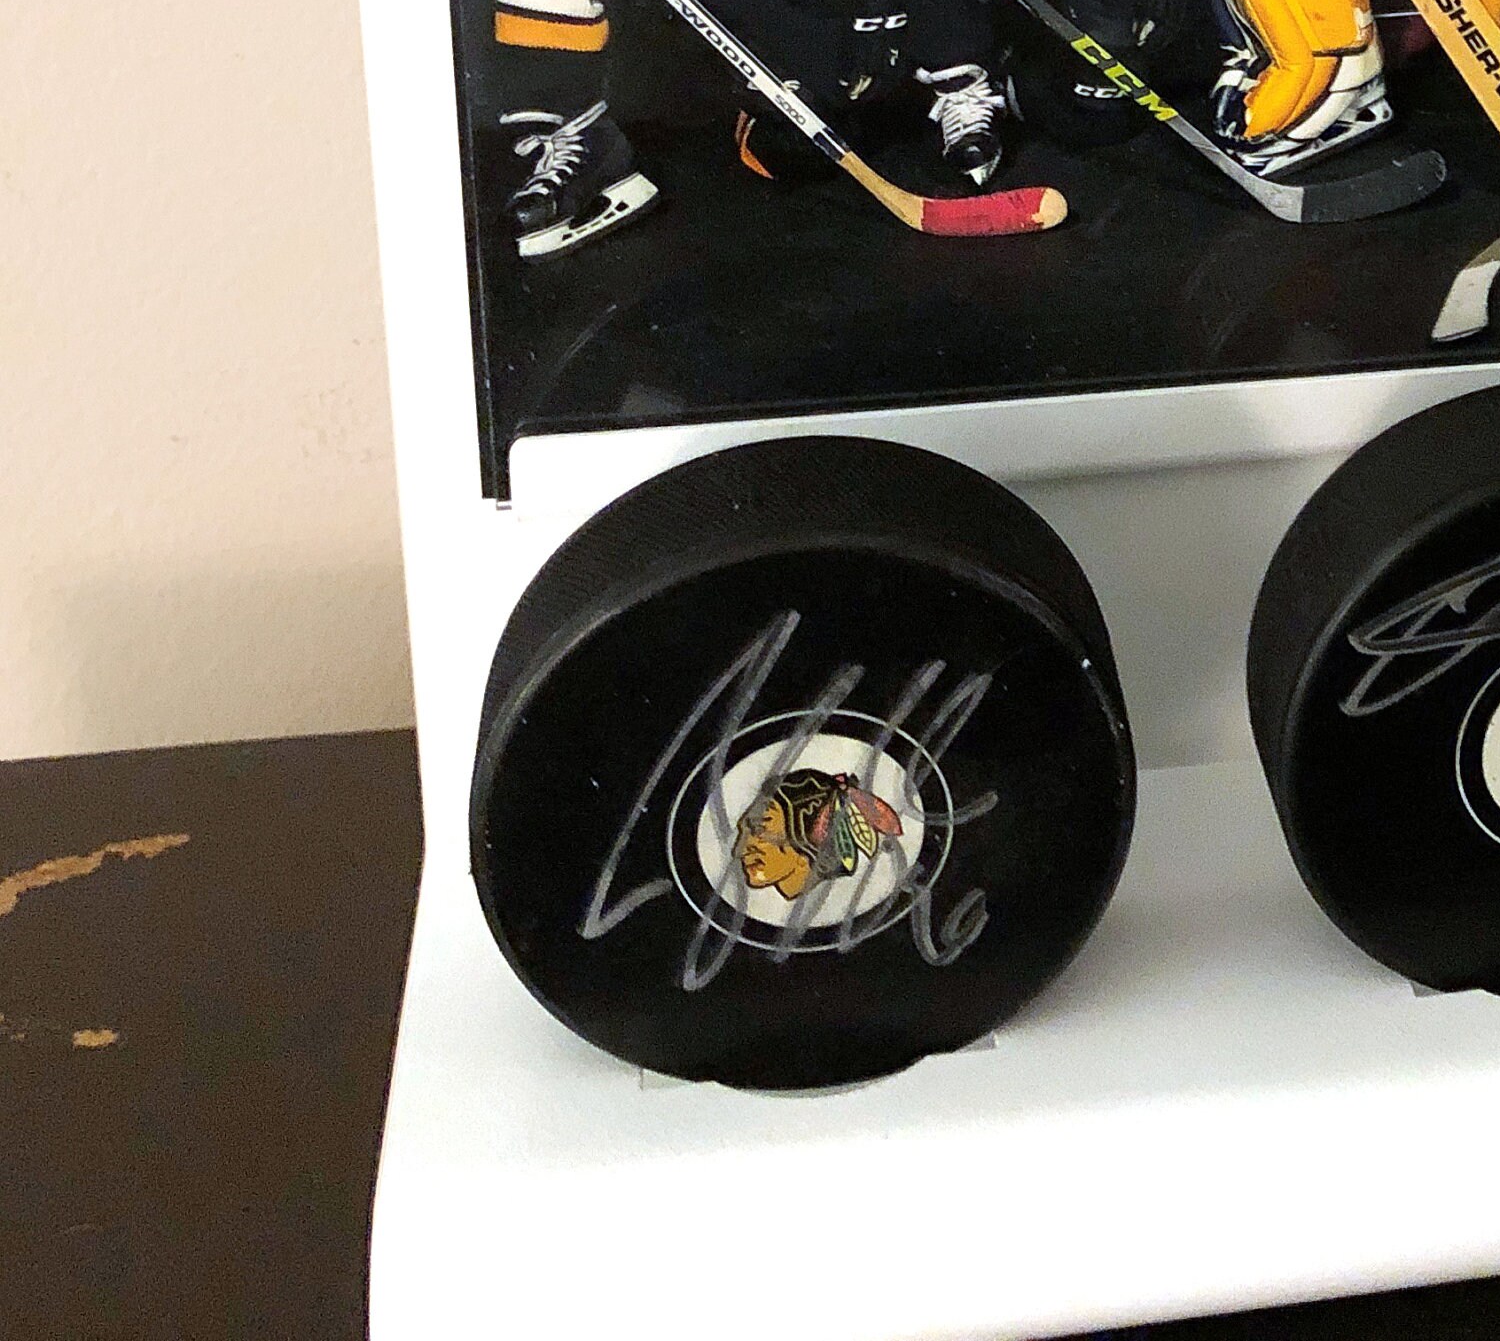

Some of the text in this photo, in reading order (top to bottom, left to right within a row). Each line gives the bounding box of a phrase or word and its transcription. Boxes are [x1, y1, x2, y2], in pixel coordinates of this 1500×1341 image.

[853, 13, 908, 32] CC
[1070, 33, 1179, 121] CCM
[774, 94, 807, 126] 5000
